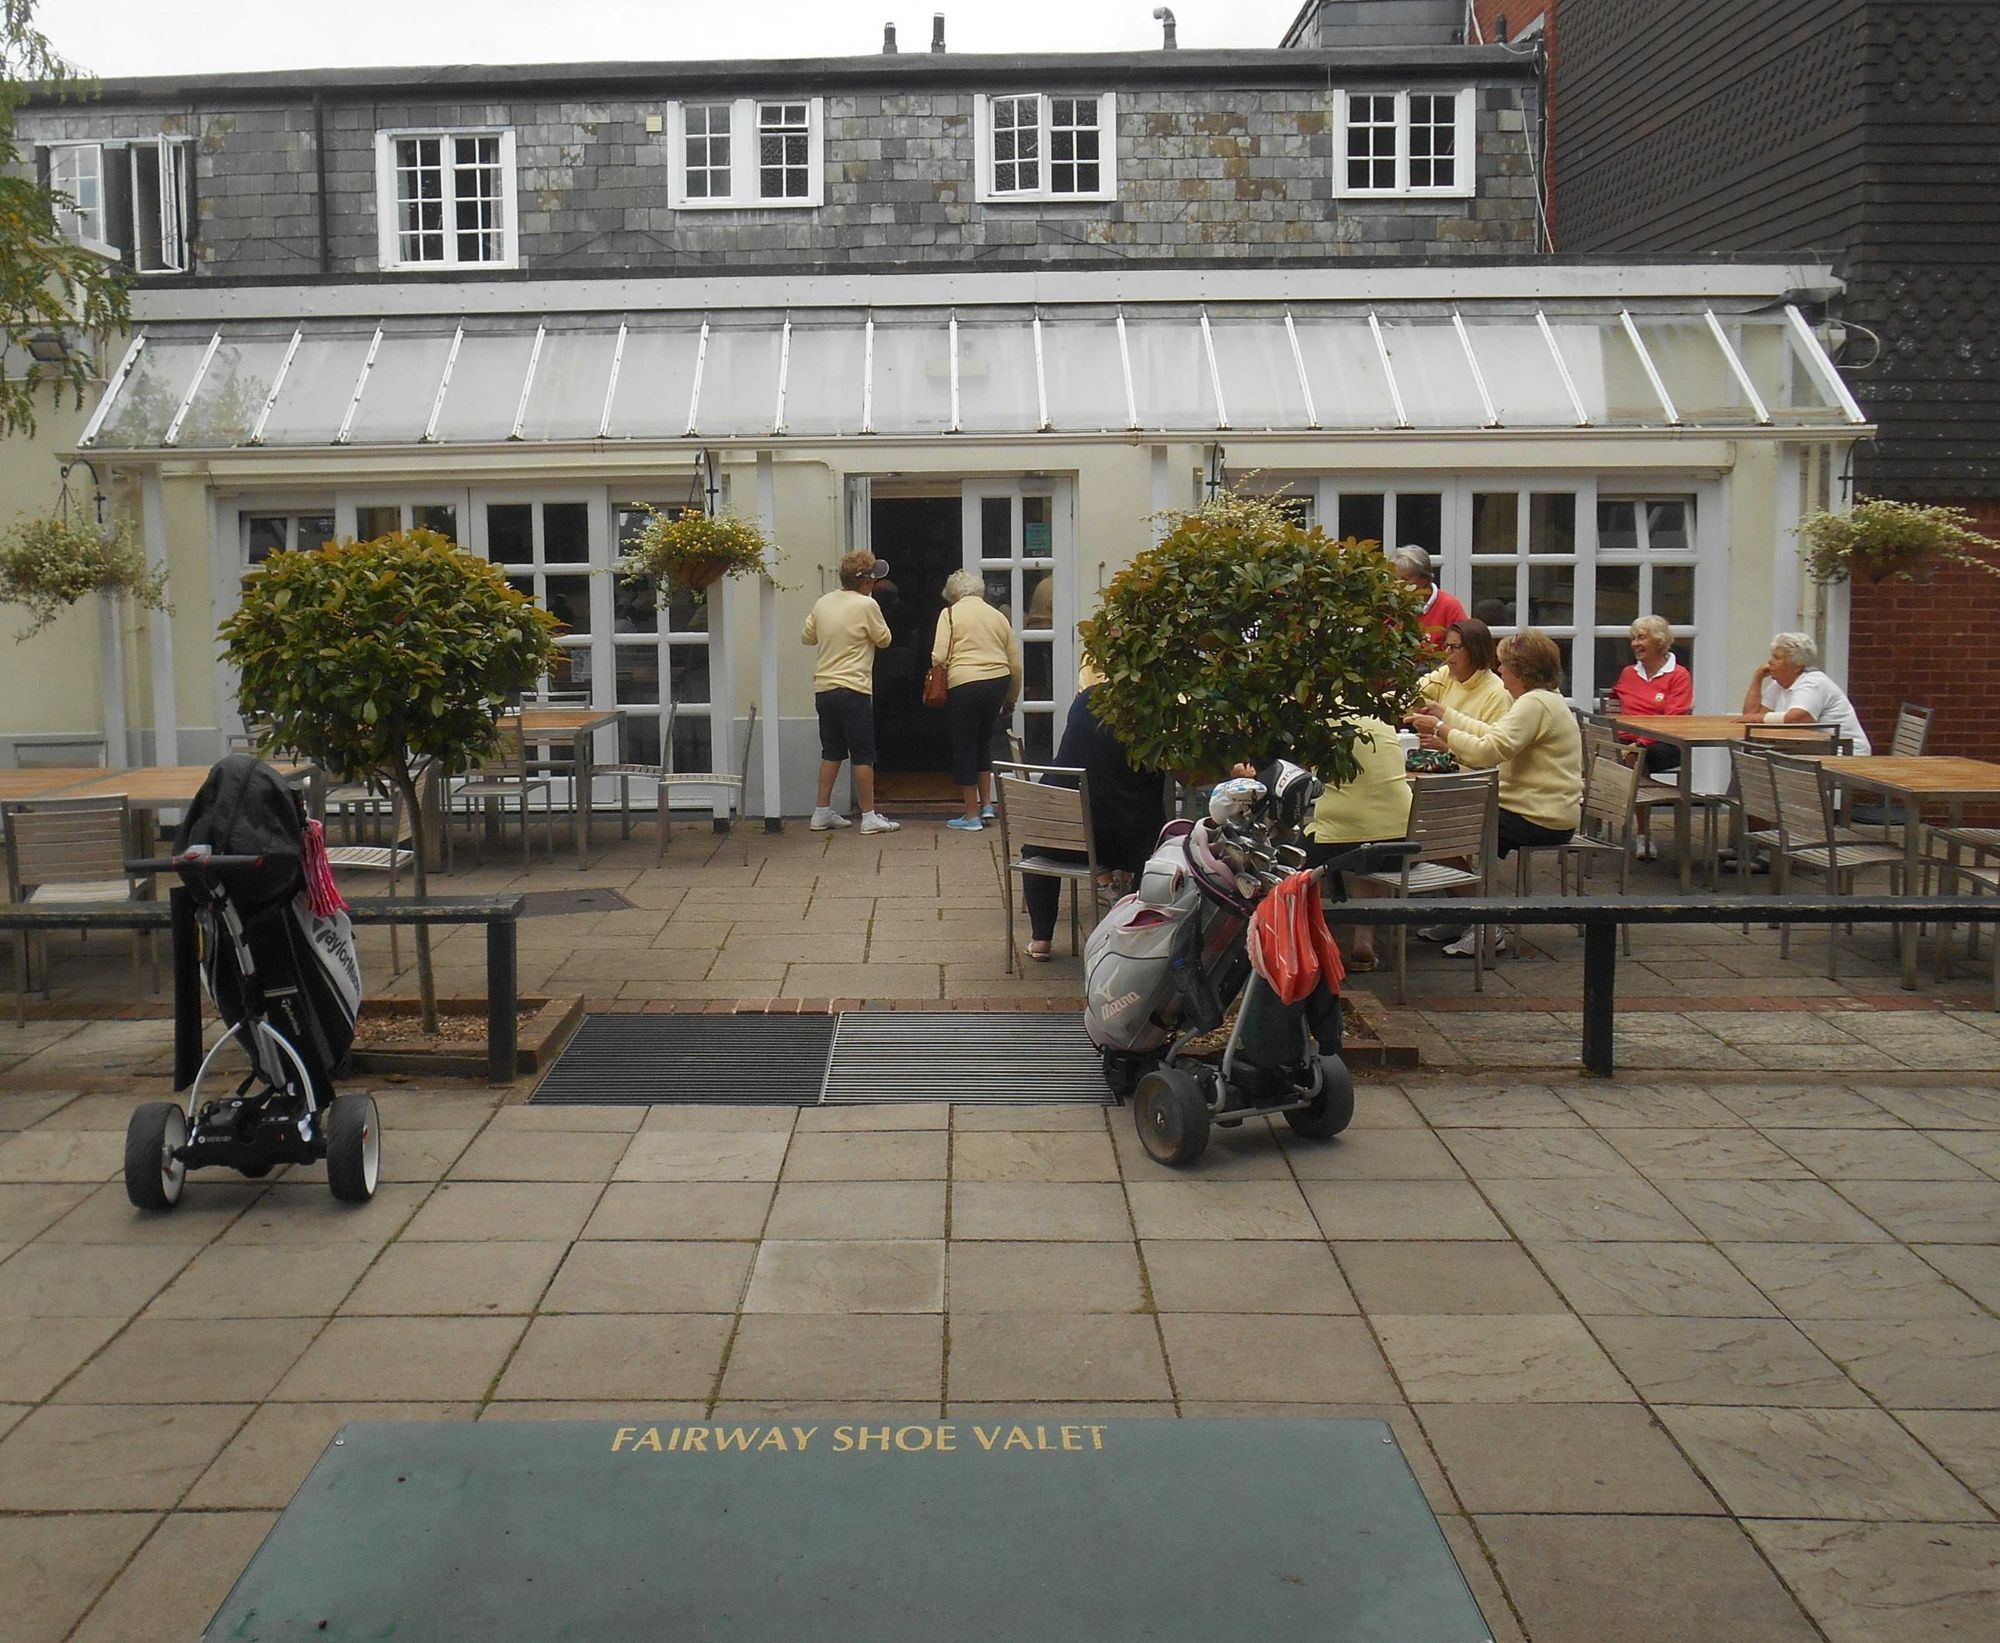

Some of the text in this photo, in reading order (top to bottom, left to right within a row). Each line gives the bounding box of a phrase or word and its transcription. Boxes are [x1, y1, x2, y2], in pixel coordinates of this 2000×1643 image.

[610, 1425, 1108, 1453] FAIRWAY SHOE VALET
